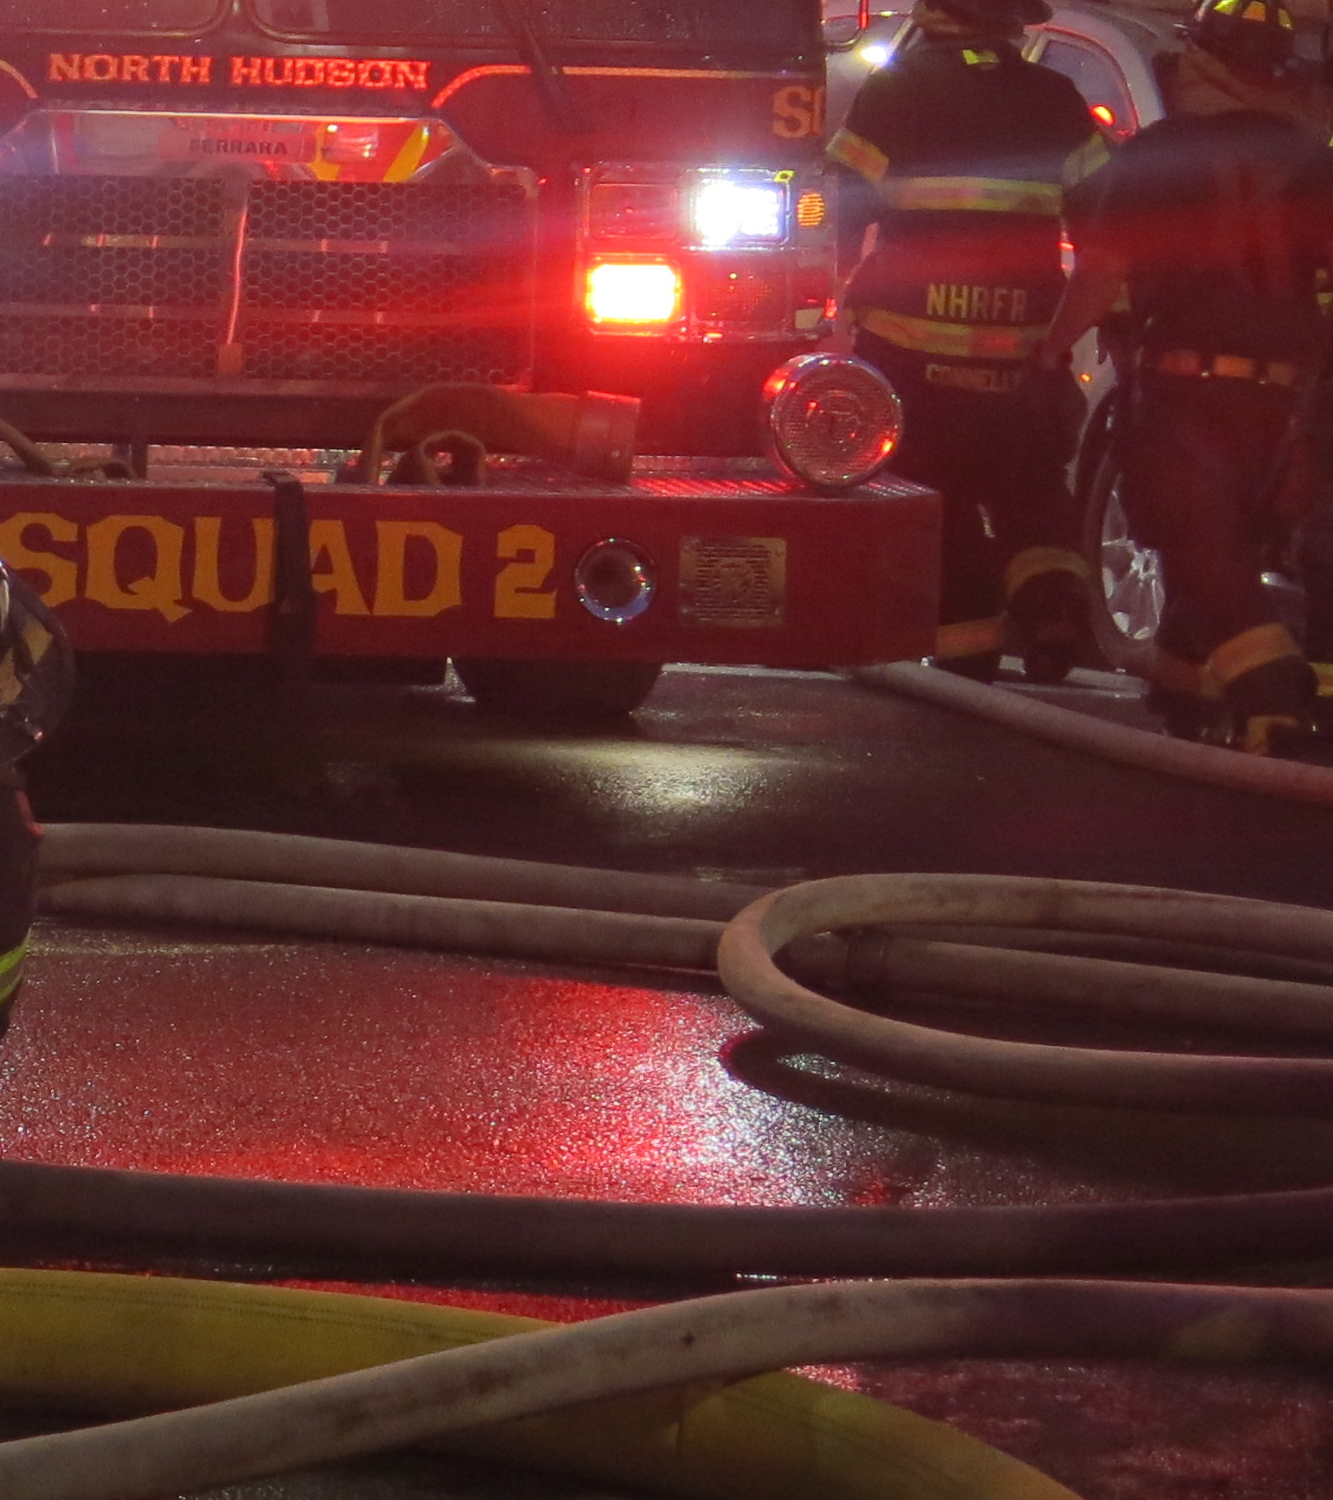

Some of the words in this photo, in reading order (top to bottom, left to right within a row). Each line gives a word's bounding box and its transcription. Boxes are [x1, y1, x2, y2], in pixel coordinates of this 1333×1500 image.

[48, 53, 212, 87] NORTH
[230, 55, 431, 92] HUDSON
[188, 138, 287, 155] FERRARA
[493, 523, 559, 619] 2
